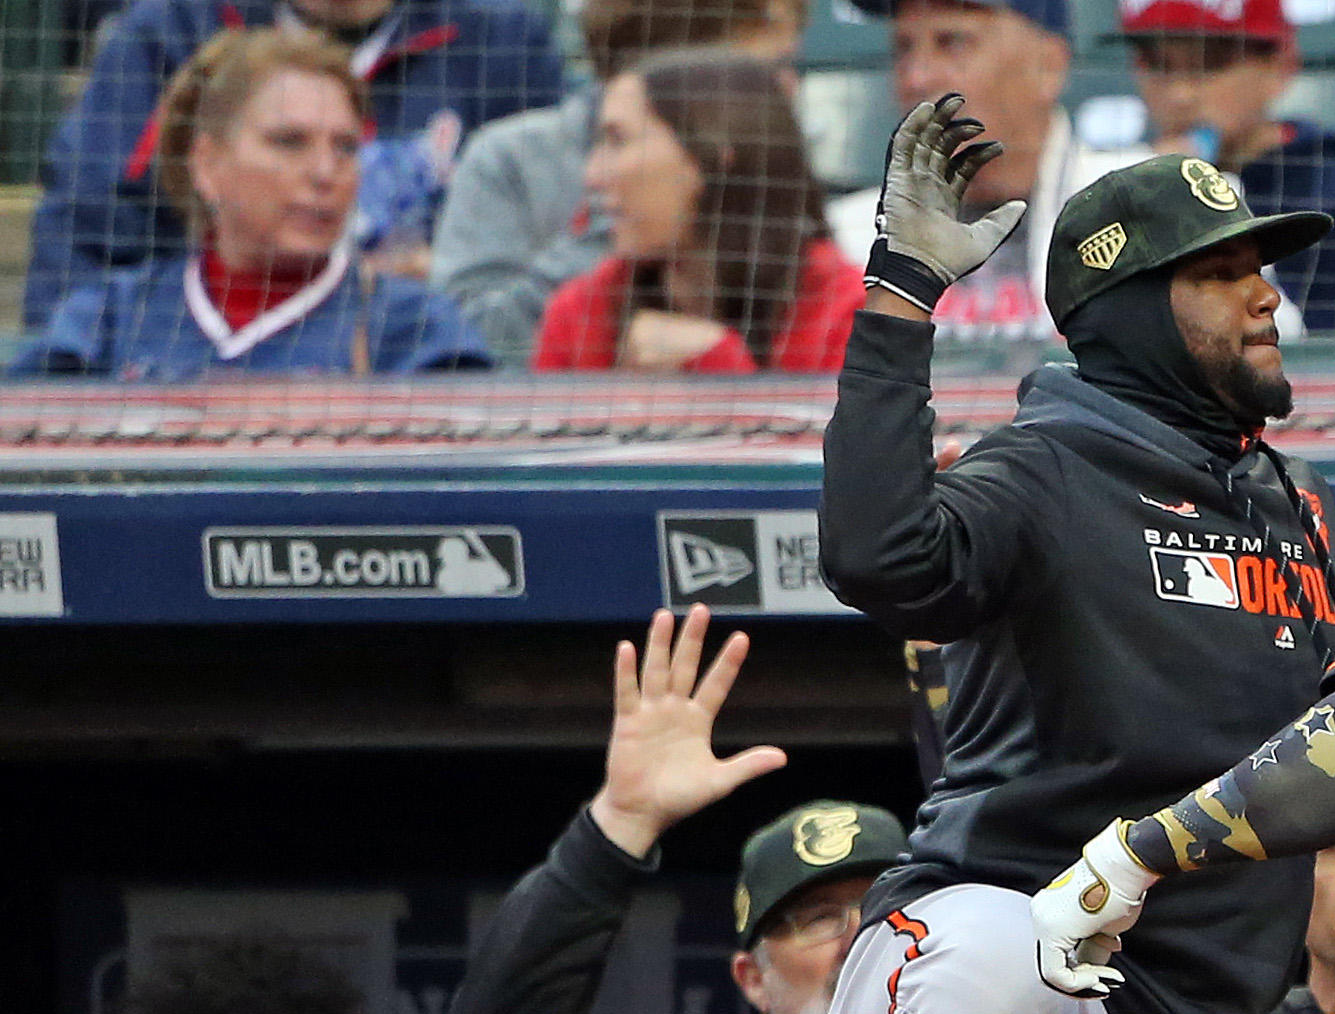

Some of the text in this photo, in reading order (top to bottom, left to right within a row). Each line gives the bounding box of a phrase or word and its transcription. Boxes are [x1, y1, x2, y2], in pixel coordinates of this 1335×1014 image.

[776, 535, 819, 562] NE
[1143, 528, 1303, 561] BALTIMRE
[217, 539, 431, 586] MLB.com
[779, 565, 820, 590] ER
